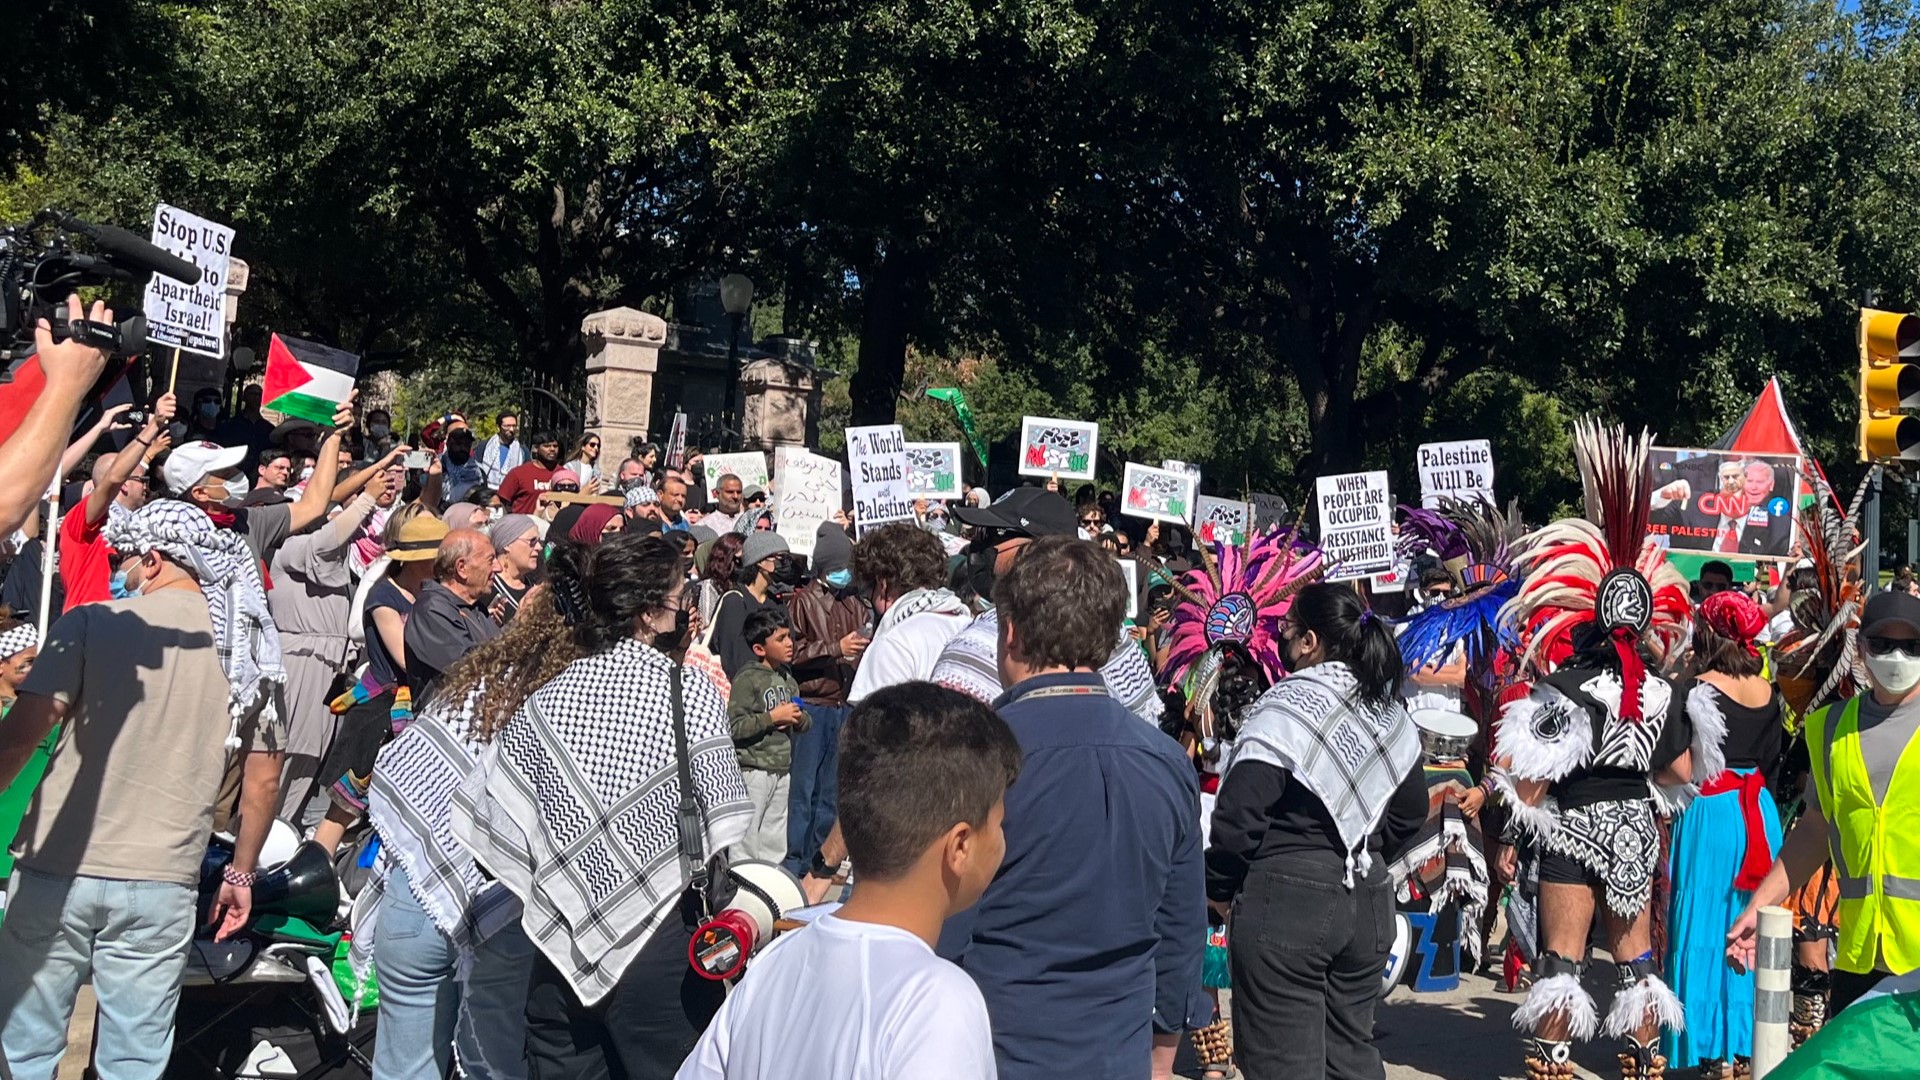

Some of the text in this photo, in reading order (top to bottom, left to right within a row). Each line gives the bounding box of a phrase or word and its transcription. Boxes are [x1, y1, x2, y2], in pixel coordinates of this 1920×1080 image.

[158, 211, 228, 256] Stop U.S.
[203, 264, 219, 287] to
[165, 302, 213, 332] Israel!
[851, 430, 904, 457] The World
[1037, 426, 1080, 448] FREE
[1421, 445, 1488, 468] Palestine
[860, 459, 902, 484] Stands
[1430, 470, 1483, 491] Will Be
[534, 479, 552, 490] lev
[1139, 473, 1178, 494] FREE
[1336, 475, 1368, 492] WHEN
[856, 495, 914, 522] Palestine
[1323, 489, 1383, 510] PEOPLE ARE
[1698, 492, 1750, 518] CNN
[1329, 505, 1382, 525] OCCUPIED,
[1327, 527, 1386, 548] RESISTANCE
[1646, 523, 1737, 540] REE PALESTINE
[1326, 543, 1389, 565] IS JUSTIFIED!
